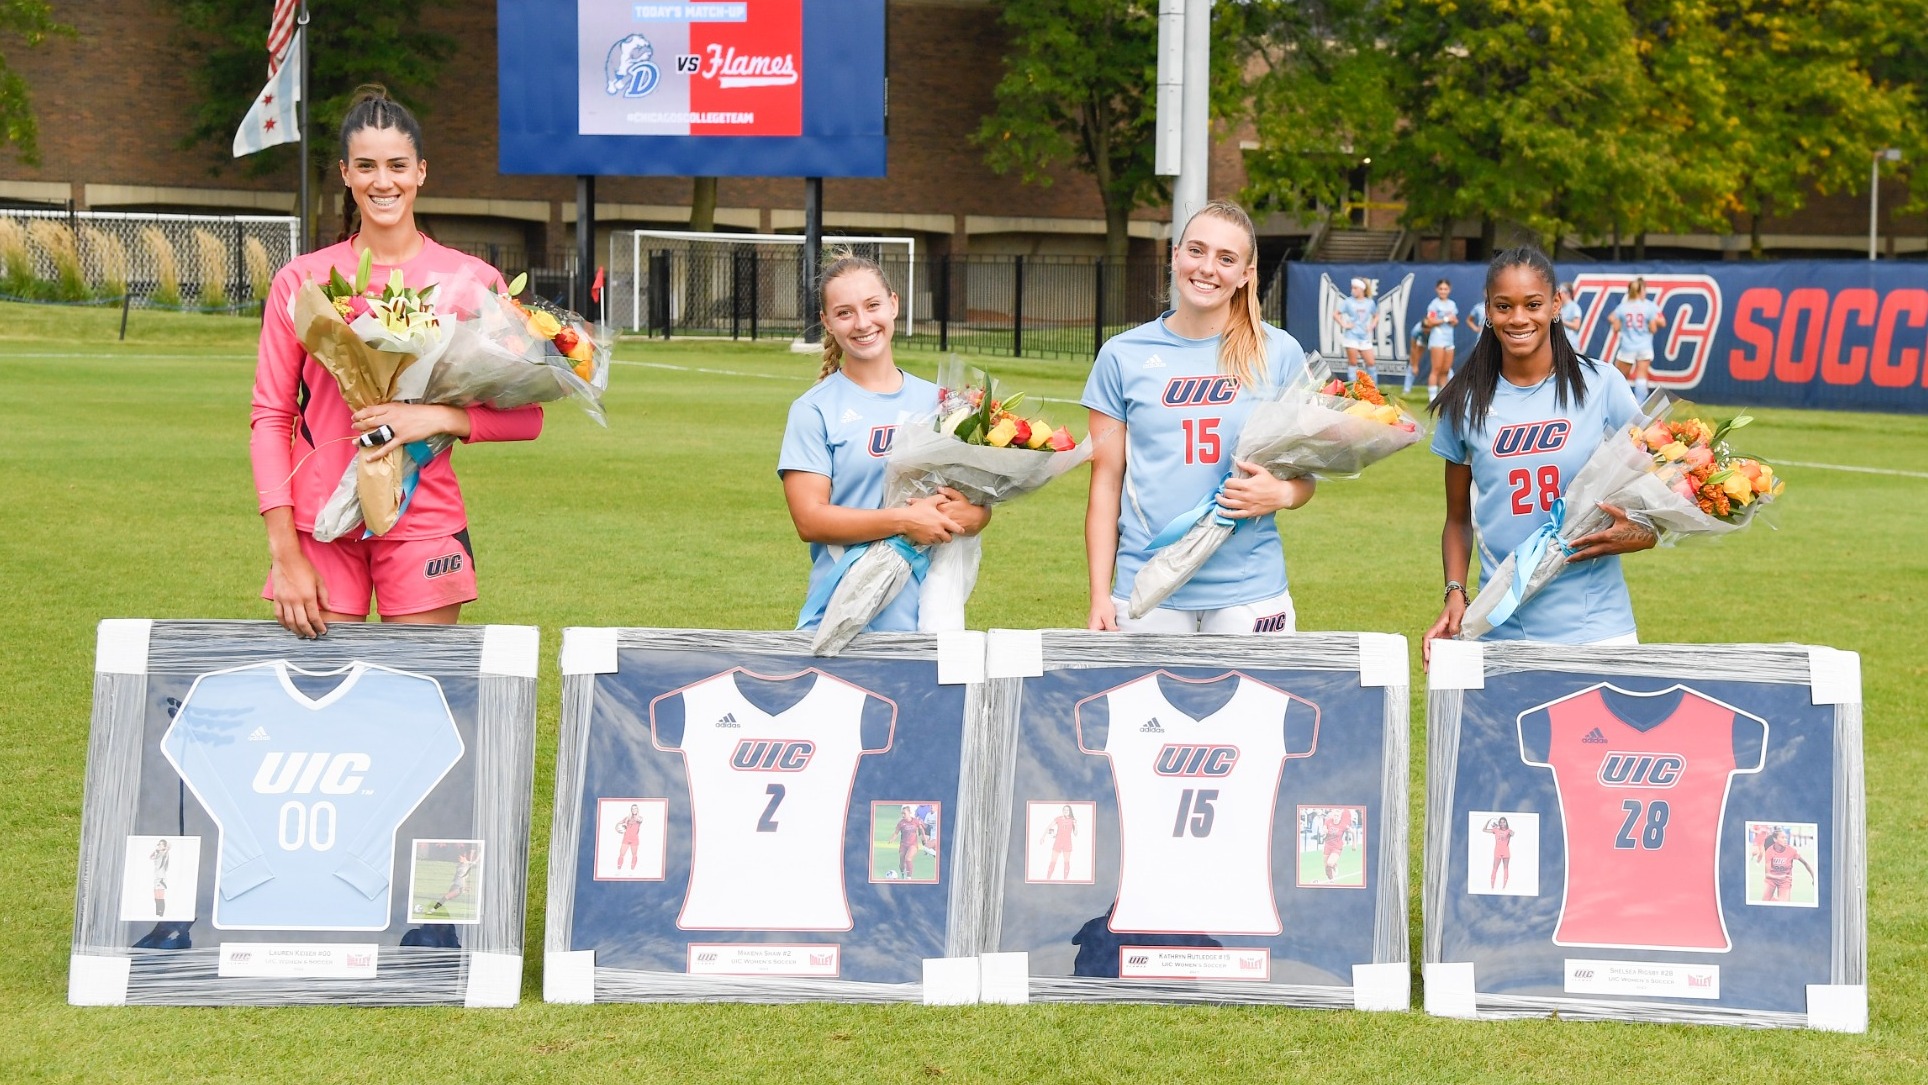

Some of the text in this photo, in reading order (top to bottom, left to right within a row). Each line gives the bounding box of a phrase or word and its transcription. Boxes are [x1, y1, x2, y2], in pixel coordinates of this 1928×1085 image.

[634, 6, 745, 18] TODAY'S MATCH-UP
[677, 55, 700, 73] VS
[702, 43, 794, 79] Flames
[1565, 275, 1928, 388] UC SOCC
[1163, 376, 1239, 406] UIC
[1182, 417, 1223, 465] 15
[1493, 420, 1571, 457] UIC
[1508, 464, 1561, 516] 28
[426, 553, 462, 577] UIC
[1253, 612, 1286, 632] UIC
[252, 752, 371, 794] UIC
[732, 740, 814, 770] UIC
[1156, 745, 1238, 776] UIC
[1600, 753, 1684, 786] UIC
[756, 783, 786, 832] 2
[1172, 789, 1220, 838] 15
[1613, 798, 1671, 851] 28
[278, 800, 337, 852] 00
[1127, 955, 1150, 965] UIC
